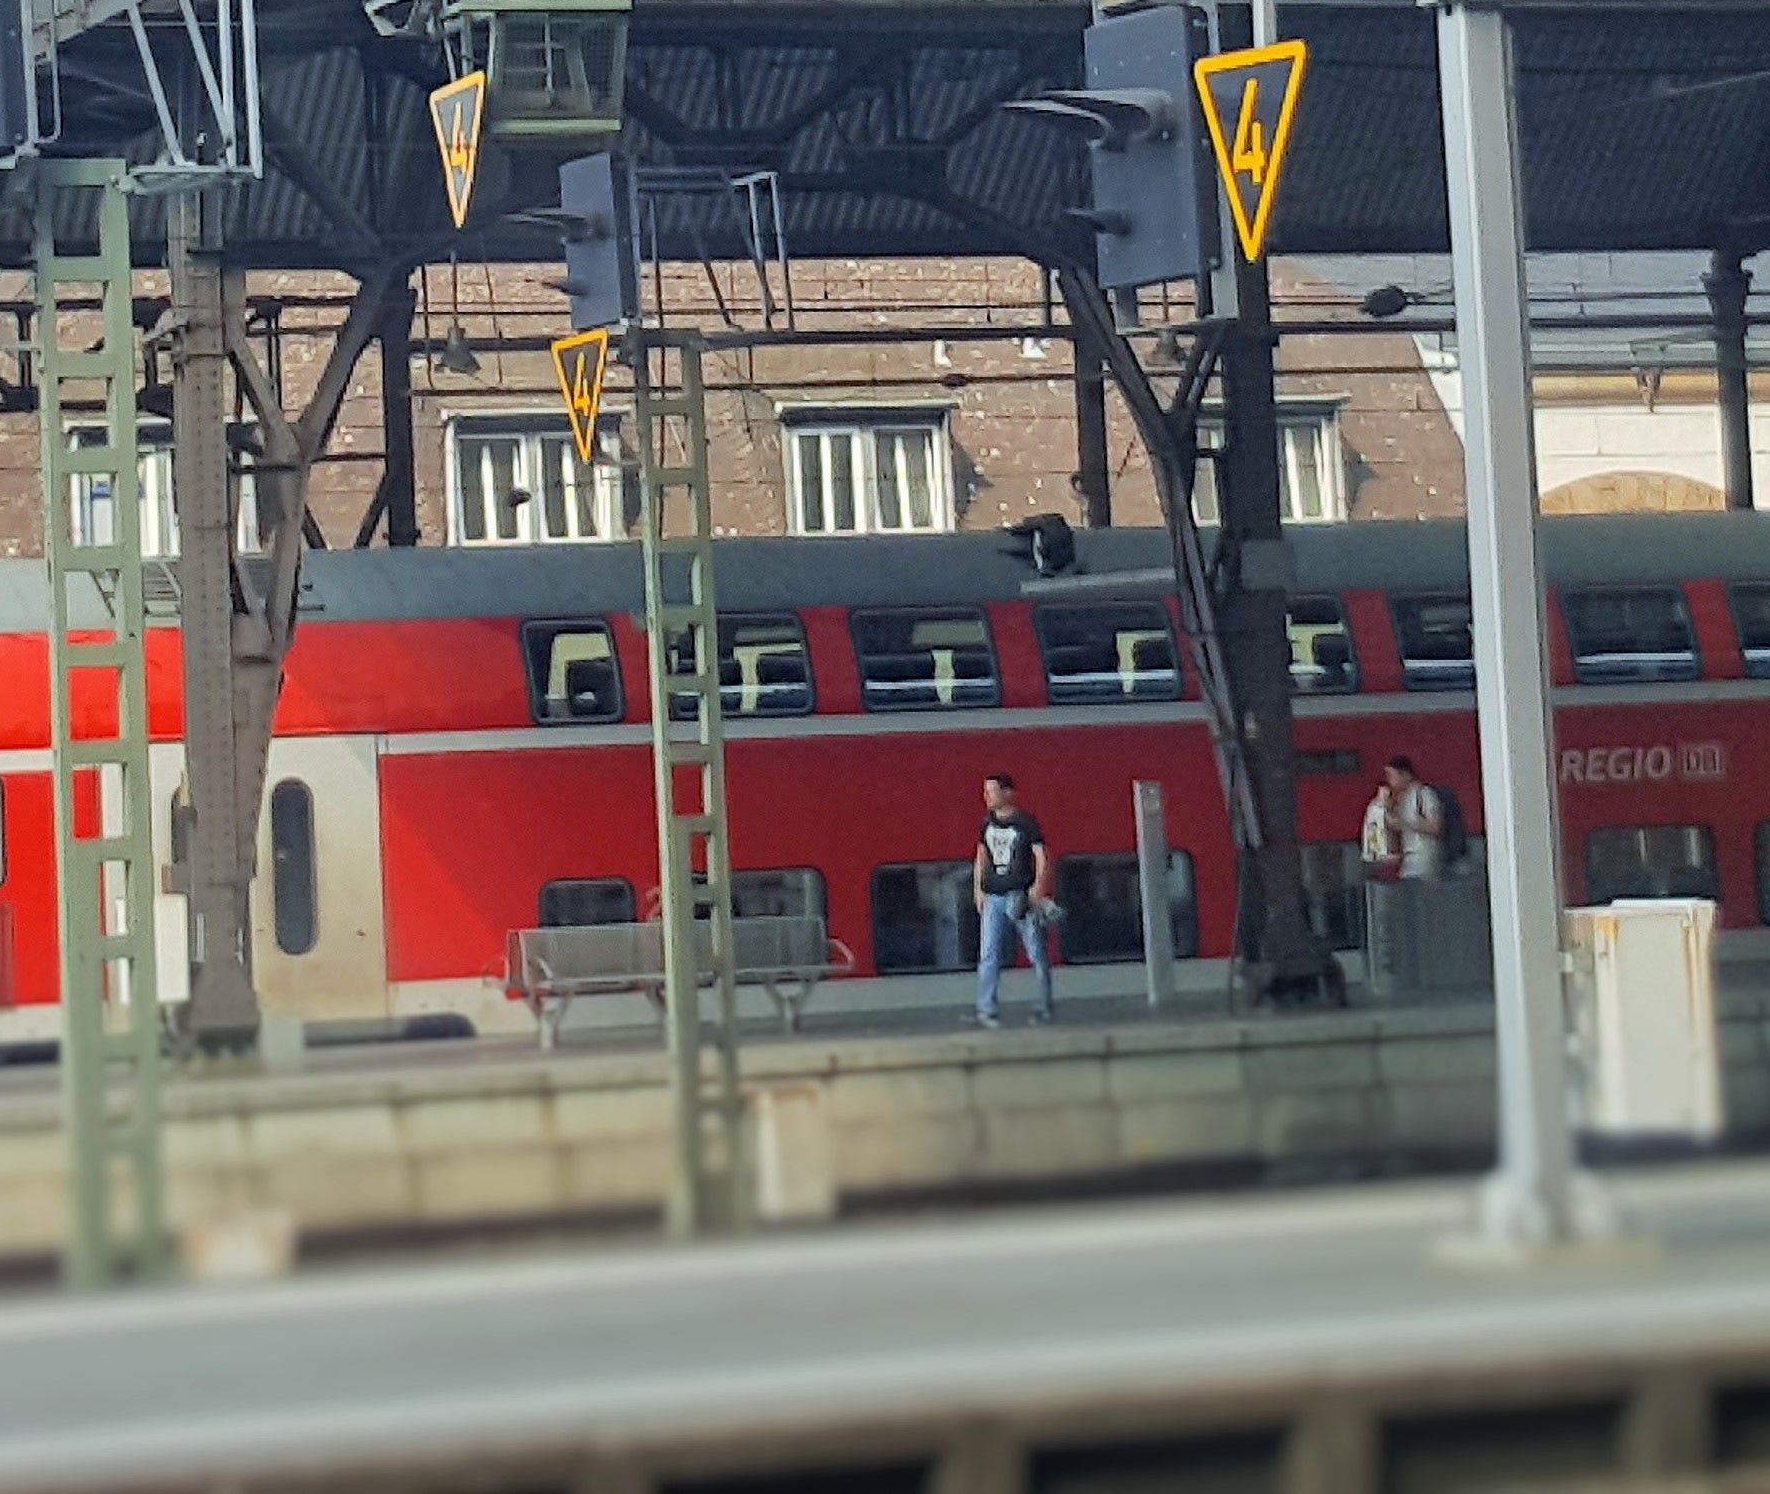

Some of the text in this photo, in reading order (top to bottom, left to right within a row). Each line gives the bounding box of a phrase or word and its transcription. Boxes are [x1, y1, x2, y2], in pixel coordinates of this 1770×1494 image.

[1232, 77, 1266, 184] 4
[573, 351, 591, 417] 4
[1560, 744, 1672, 783] REGIO
